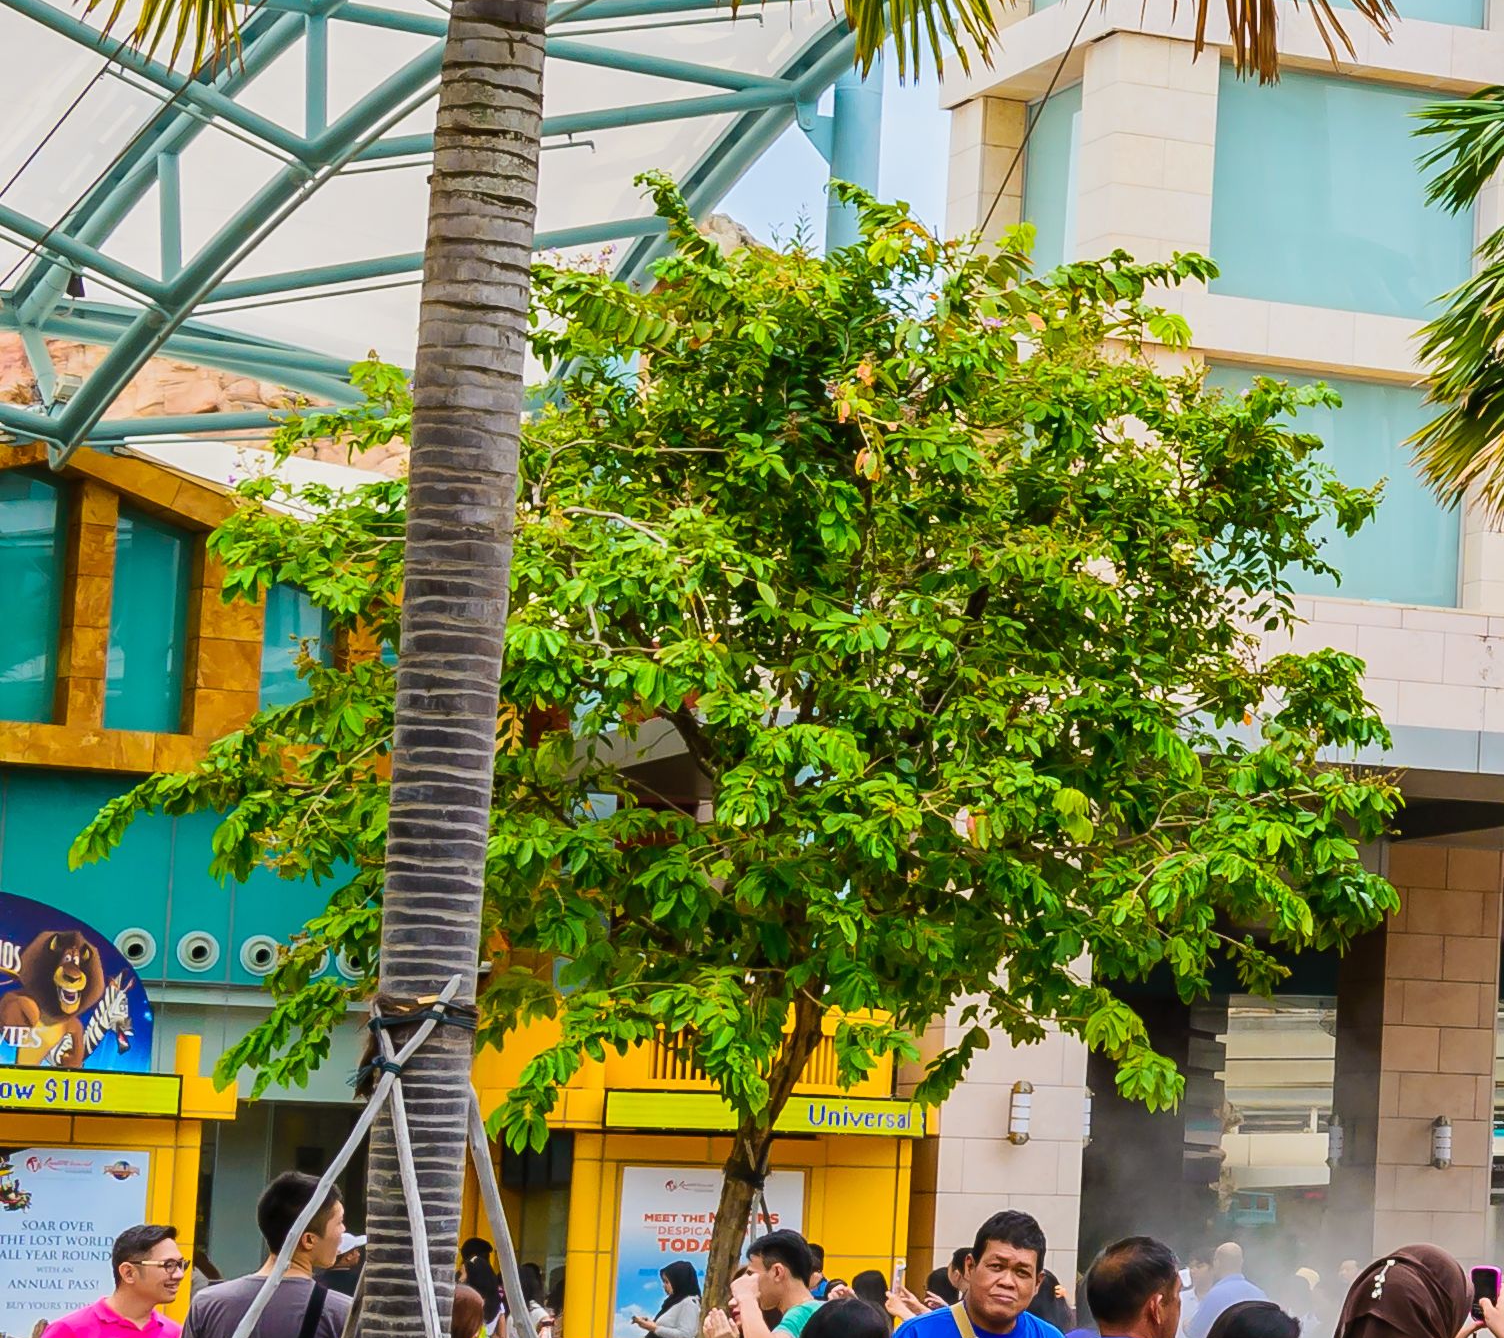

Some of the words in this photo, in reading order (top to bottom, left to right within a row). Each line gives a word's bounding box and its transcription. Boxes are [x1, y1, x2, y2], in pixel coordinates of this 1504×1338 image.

[45, 1078, 102, 1102] $188
[809, 1104, 911, 1129] Universal
[644, 1213, 678, 1223] MEET
[681, 1214, 705, 1224] THE
[21, 1220, 56, 1232] SOAR
[59, 1221, 94, 1232] OVER
[658, 1226, 712, 1236] DESPICA
[0, 1234, 25, 1246] THE
[29, 1235, 63, 1247] LOST
[65, 1236, 114, 1247] WORLD
[657, 1238, 712, 1253] TODA
[0, 1249, 21, 1261] ALL
[25, 1250, 57, 1261] YEAR
[62, 1250, 112, 1262] ROUND
[62, 1266, 74, 1274] AN
[7, 1279, 64, 1290] ANNUAL
[68, 1279, 99, 1290] PASS!
[6, 1301, 25, 1310] BUY
[28, 1302, 61, 1310] YOURS
[64, 1302, 92, 1311] TOD
